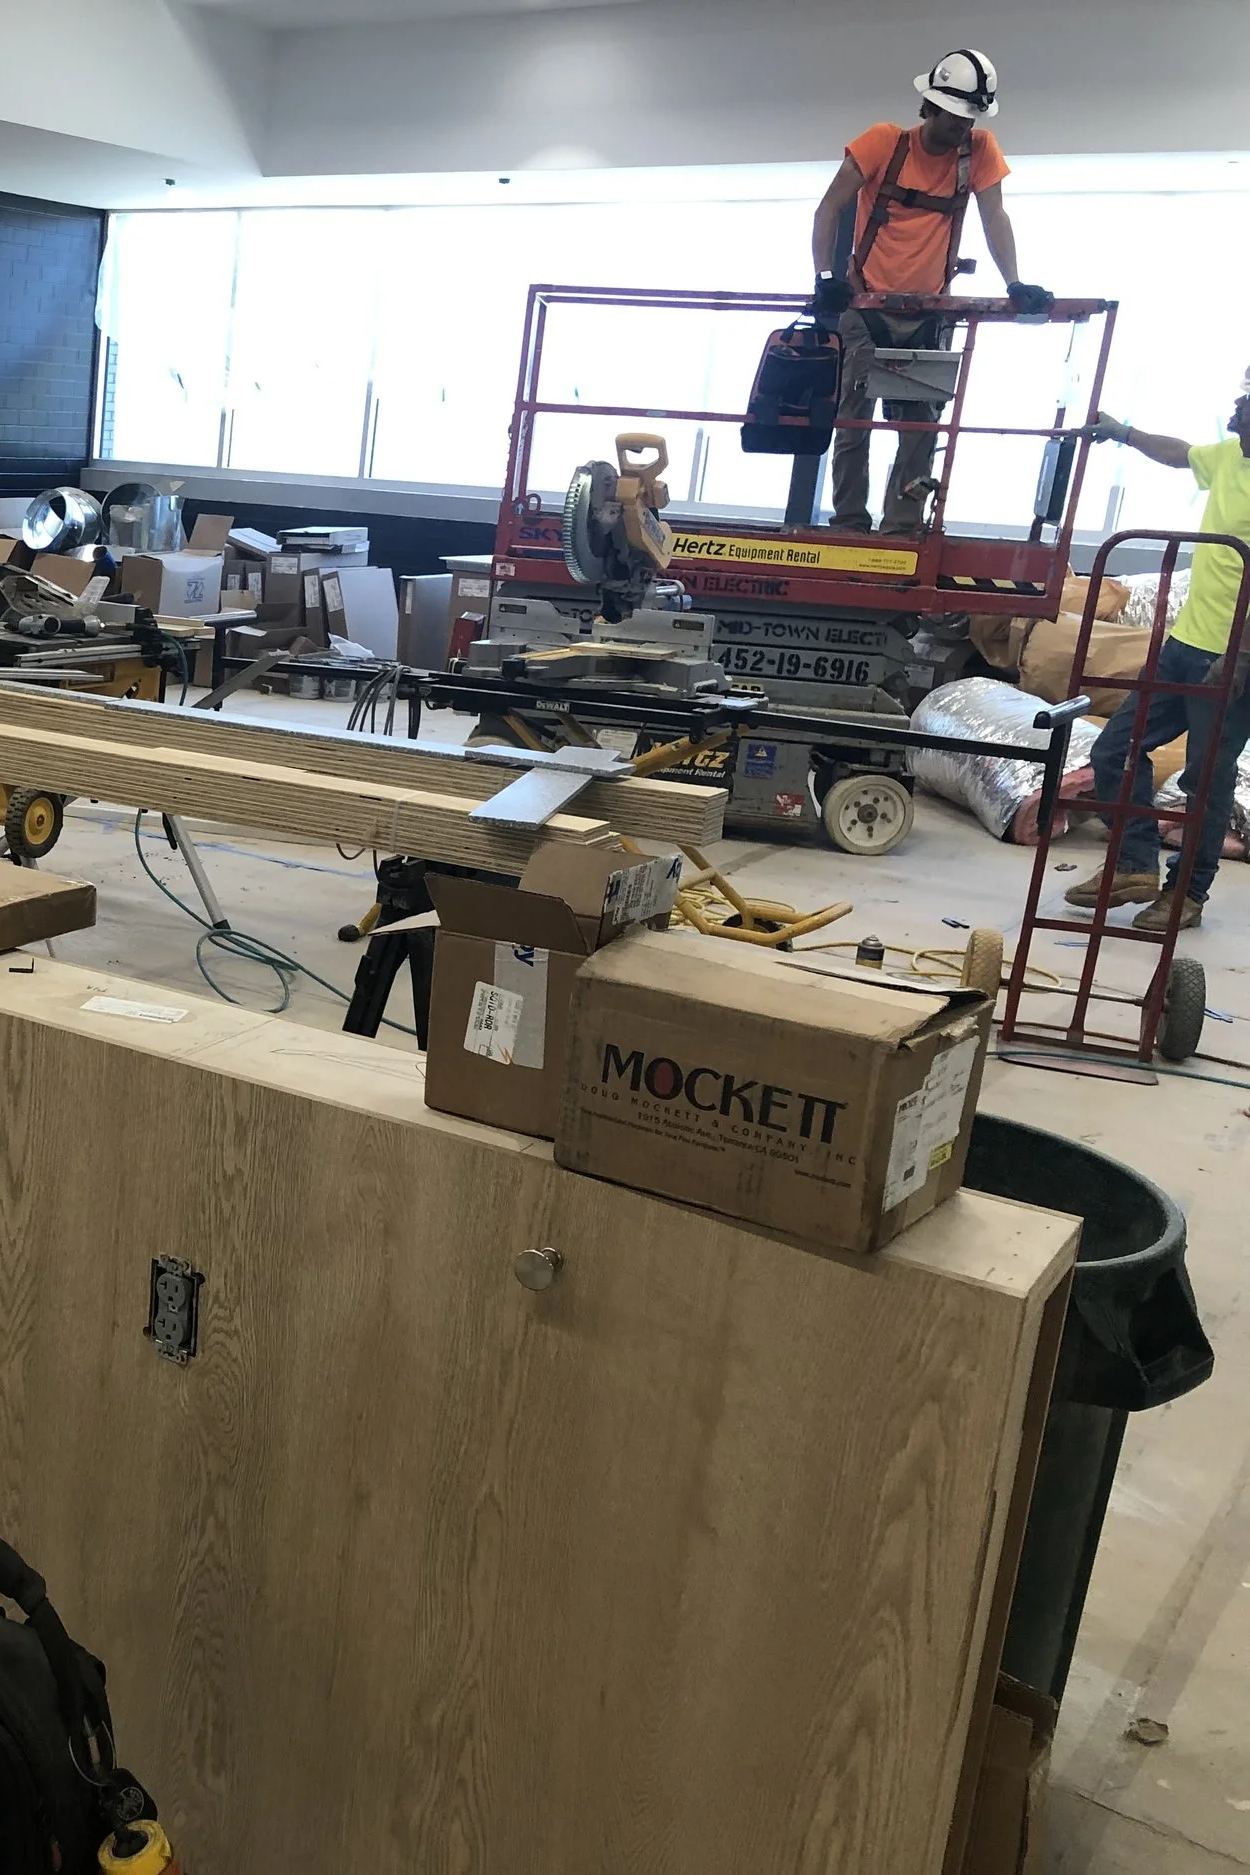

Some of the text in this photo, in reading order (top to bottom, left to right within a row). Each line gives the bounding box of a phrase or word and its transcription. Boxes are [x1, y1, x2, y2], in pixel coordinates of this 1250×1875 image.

[672, 537, 820, 564] Hertz Equipment Rental
[703, 576, 791, 597] ELECTRIC
[716, 619, 820, 641] MID-TOWN
[718, 646, 871, 684] 452-19-6916
[701, 768, 727, 779] Rental
[581, 1083, 620, 1101] DOUG
[629, 1096, 700, 1123] MOCKETT
[711, 1119, 719, 1129] &
[601, 1043, 847, 1145] MOCKETT
[637, 1111, 661, 1125] 1915
